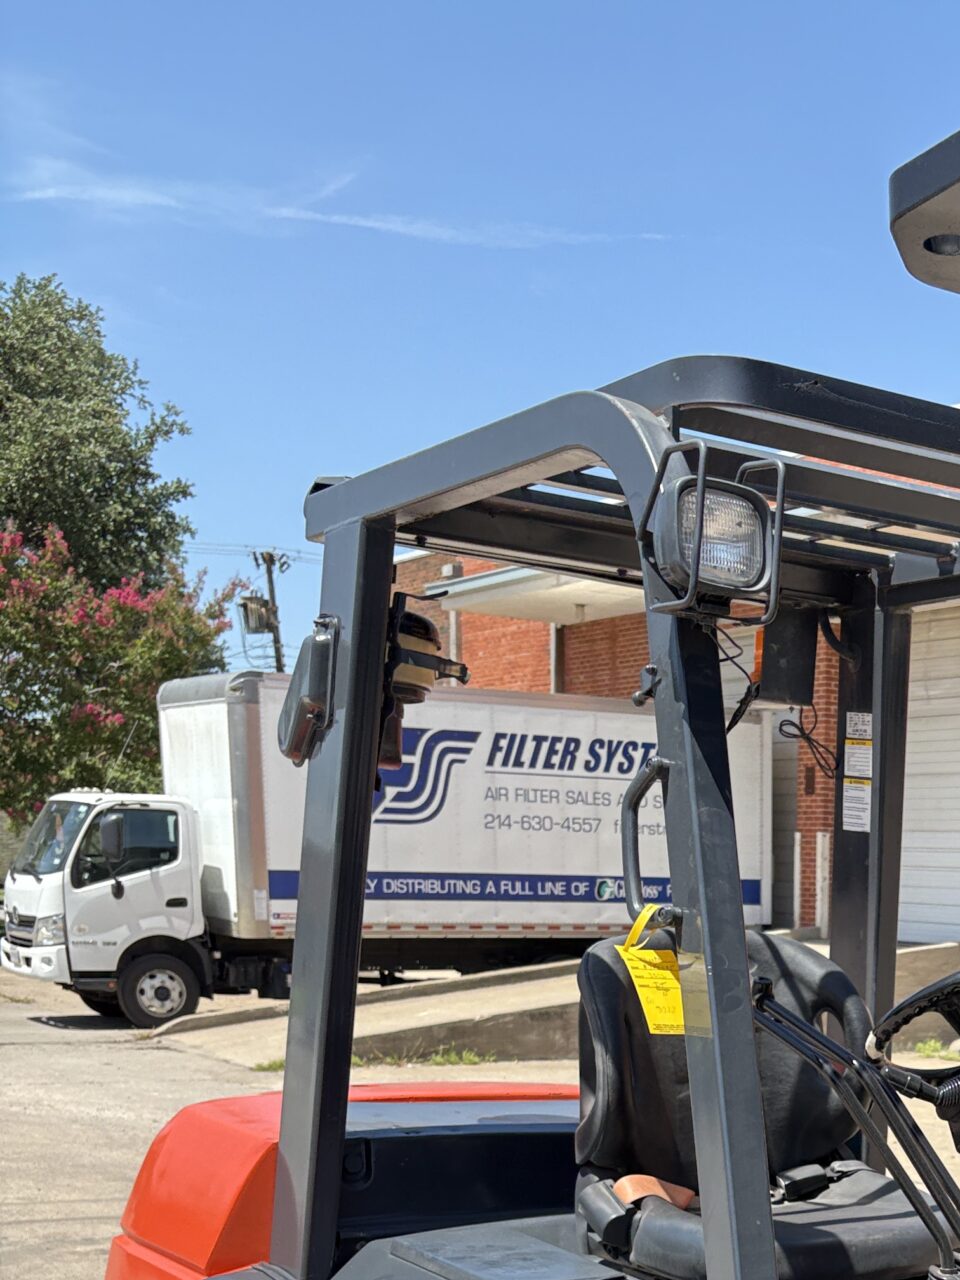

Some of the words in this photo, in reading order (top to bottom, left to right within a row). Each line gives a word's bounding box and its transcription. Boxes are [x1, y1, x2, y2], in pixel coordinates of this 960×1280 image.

[486, 732, 581, 771] FILTER
[584, 738, 658, 774] SYST
[484, 786, 509, 802] AIR
[515, 788, 560, 805] FILTER
[565, 790, 611, 807] SALES
[617, 793, 648, 809] AD
[484, 813, 602, 833] 214-630-4557
[383, 878, 480, 894] DISTRIBUTING
[485, 880, 497, 895] A
[500, 880, 533, 895] FULL
[537, 881, 566, 896] LINE
[571, 882, 589, 896] OF
